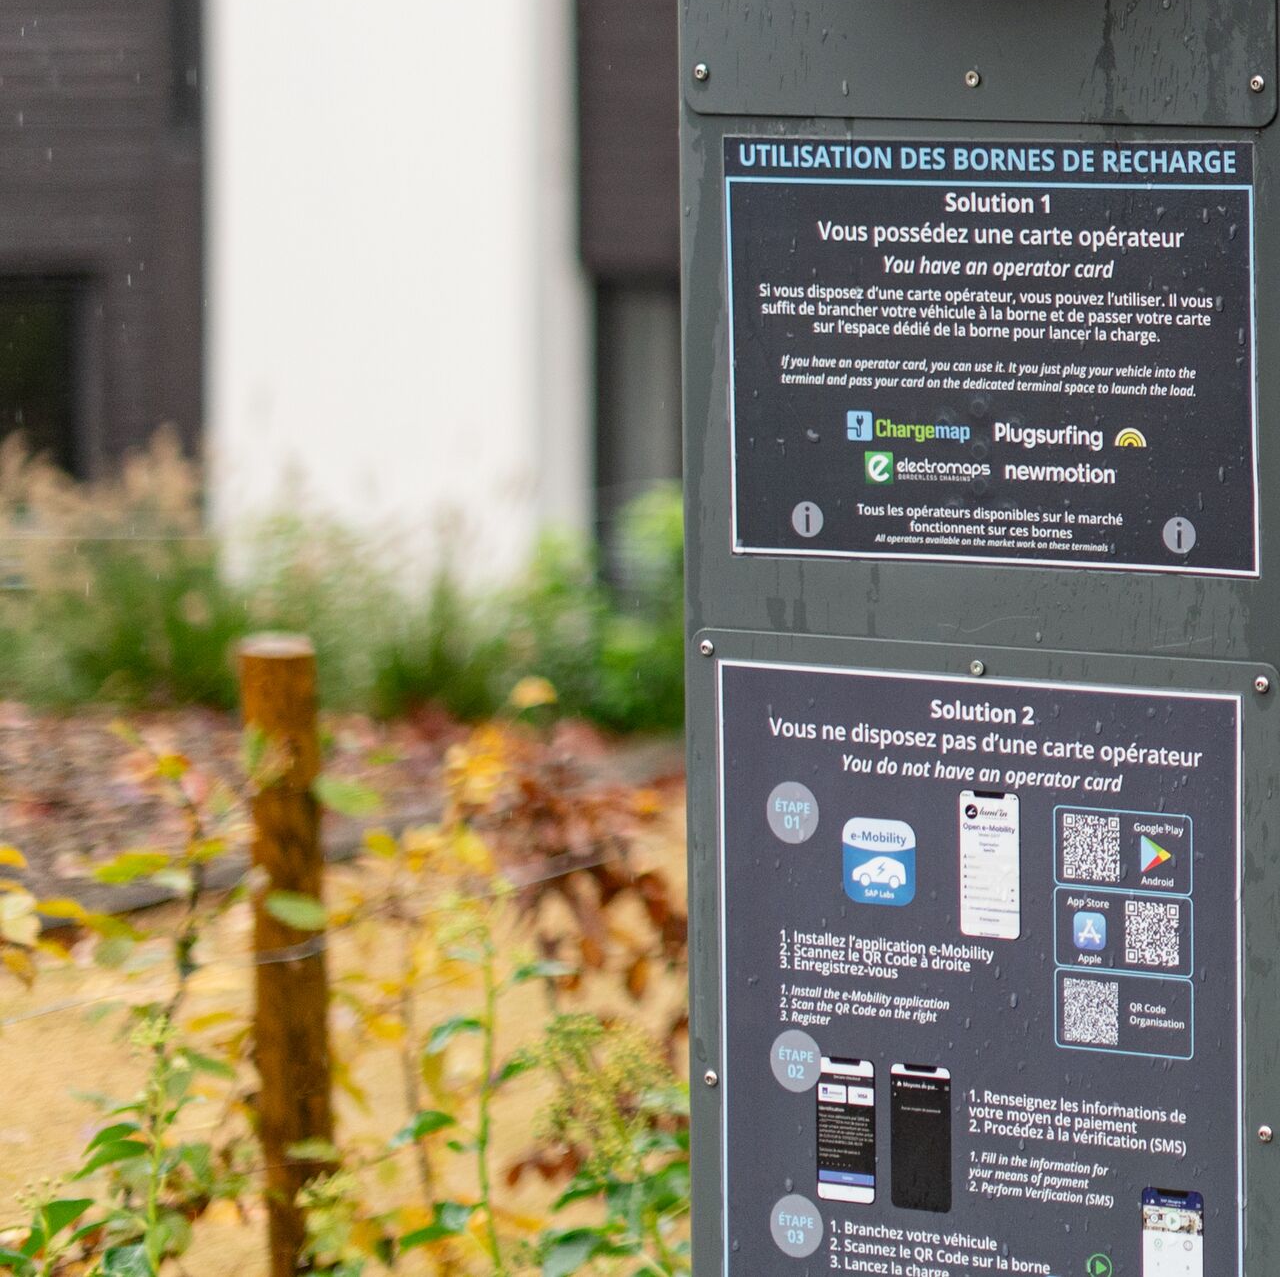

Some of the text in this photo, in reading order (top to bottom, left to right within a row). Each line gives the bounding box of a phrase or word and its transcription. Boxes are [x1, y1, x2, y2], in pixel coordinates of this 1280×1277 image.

[739, 145, 1236, 173] UTILISATION DES BORNES DE RECHARGE
[944, 192, 1050, 214] Solution 1
[817, 221, 1184, 253] Vous possédez une carte opérateur
[882, 255, 1114, 282] You have an operator card
[759, 283, 1213, 308] Si vous disposez d'une carte opérateur, vous pouvez l'utiliser. Il vous
[761, 300, 1211, 327] suffit de brancher votre véhicule à la borne et de passer votre carte
[813, 320, 1160, 345] sur l'espace dédié de la borne pour lancer la charge.
[875, 419, 971, 443] Chargemap
[994, 422, 1104, 450] Plugsurfing
[896, 457, 991, 479] electromaps
[1004, 462, 1117, 483] newmotion
[856, 501, 1123, 525] Tous les opérateurs disponibles sur le marché
[909, 520, 1072, 538] fonctionnent sur ces bornes
[930, 700, 1034, 724] Solution 2
[769, 716, 1202, 770] Vous ne disposez pas d'une carte opérateur
[841, 753, 1123, 792] You do not have an operator card
[774, 798, 810, 814] ÉTAPE
[783, 815, 799, 830] 01
[1133, 823, 1183, 838] Google Play
[850, 829, 907, 850] e-Mobility
[1140, 876, 1174, 887] Android
[864, 888, 894, 899] SAP Labs
[1066, 897, 1109, 910] App Store
[779, 942, 970, 971] 2. Scannez le QR Code à droite
[780, 929, 994, 962] 1. Installez l'application e-Mobility
[779, 956, 898, 979] 3. Enregistrez-vous
[1077, 953, 1102, 967] Apple
[1129, 1002, 1166, 1015] QR Code
[1129, 1016, 1184, 1032] Organisation
[778, 1047, 813, 1062] ÉTAPE
[787, 1064, 804, 1079] 02
[969, 1088, 1186, 1123] 1. Renseignez les informations de
[968, 1104, 1137, 1136] votre moyen de paiement
[969, 1119, 1186, 1156] 2. Procédez à la vérification (SMS)
[778, 1212, 813, 1227] ÉTAPE
[786, 1230, 804, 1245] 03
[830, 1219, 997, 1249] 1. Branchez votre véhicule
[829, 1237, 1050, 1273] 2. Scannez le QR Code sur la borne
[830, 1254, 949, 1277] 3. Lancez la charge
